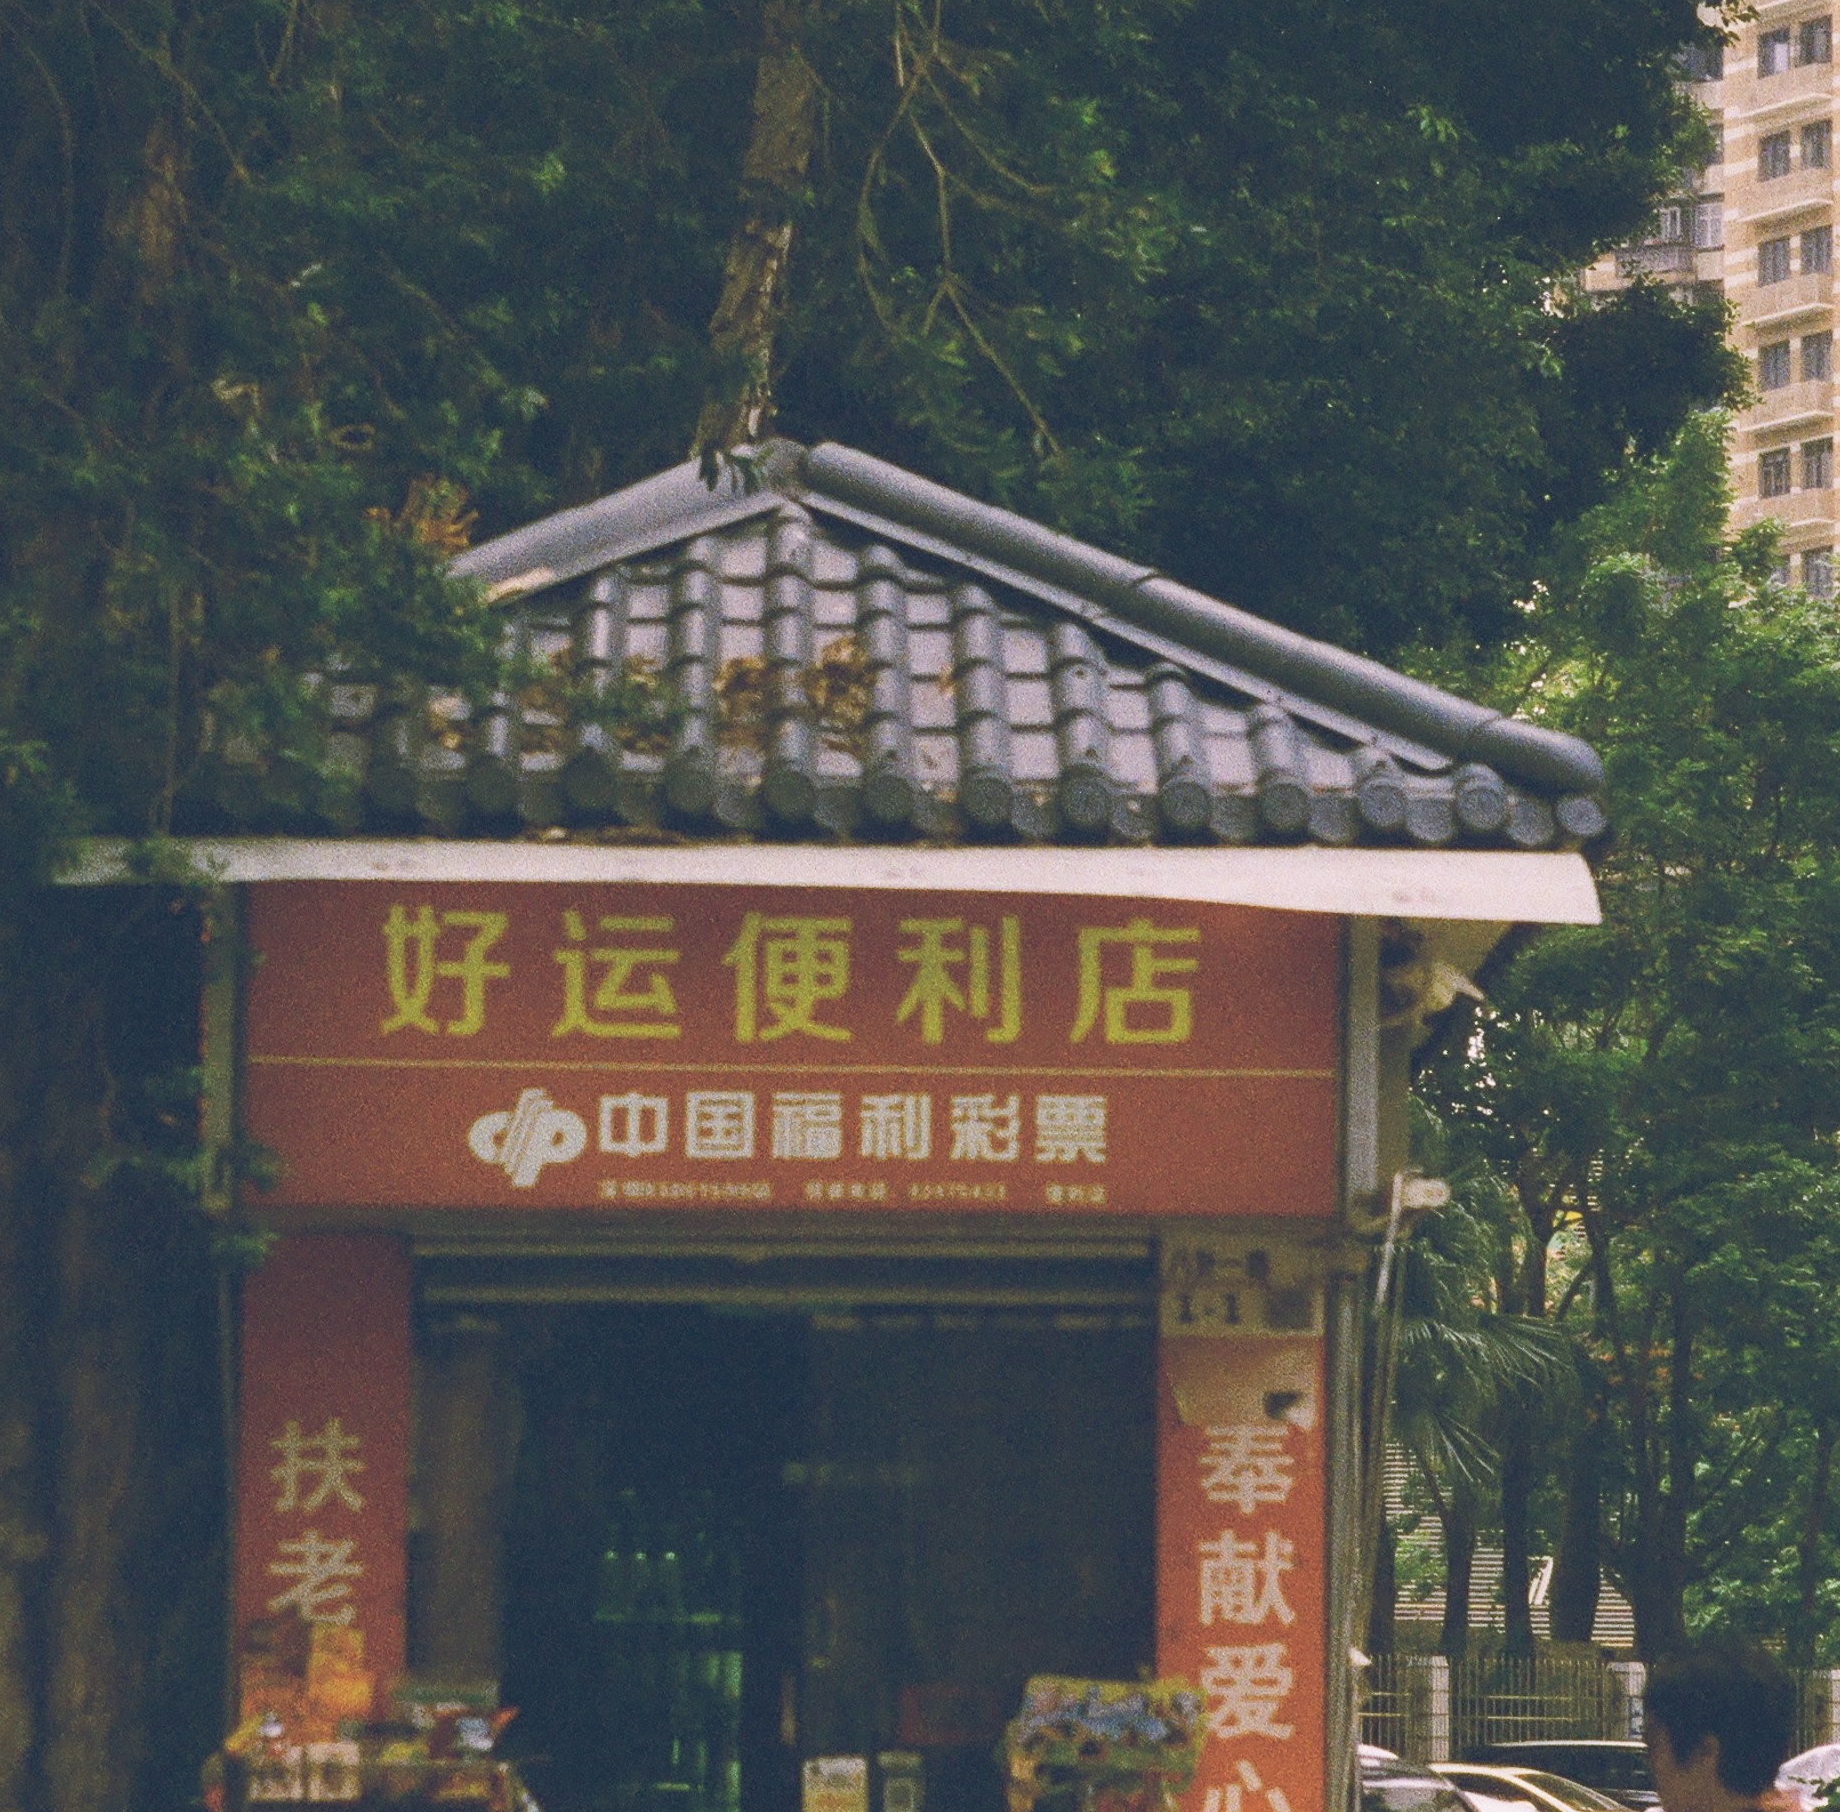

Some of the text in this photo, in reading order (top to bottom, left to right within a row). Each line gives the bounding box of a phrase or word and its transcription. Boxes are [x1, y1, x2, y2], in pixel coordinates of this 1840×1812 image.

[380, 904, 1202, 1046] 好运便利店
[598, 1090, 1108, 1164] 中国福利彩票
